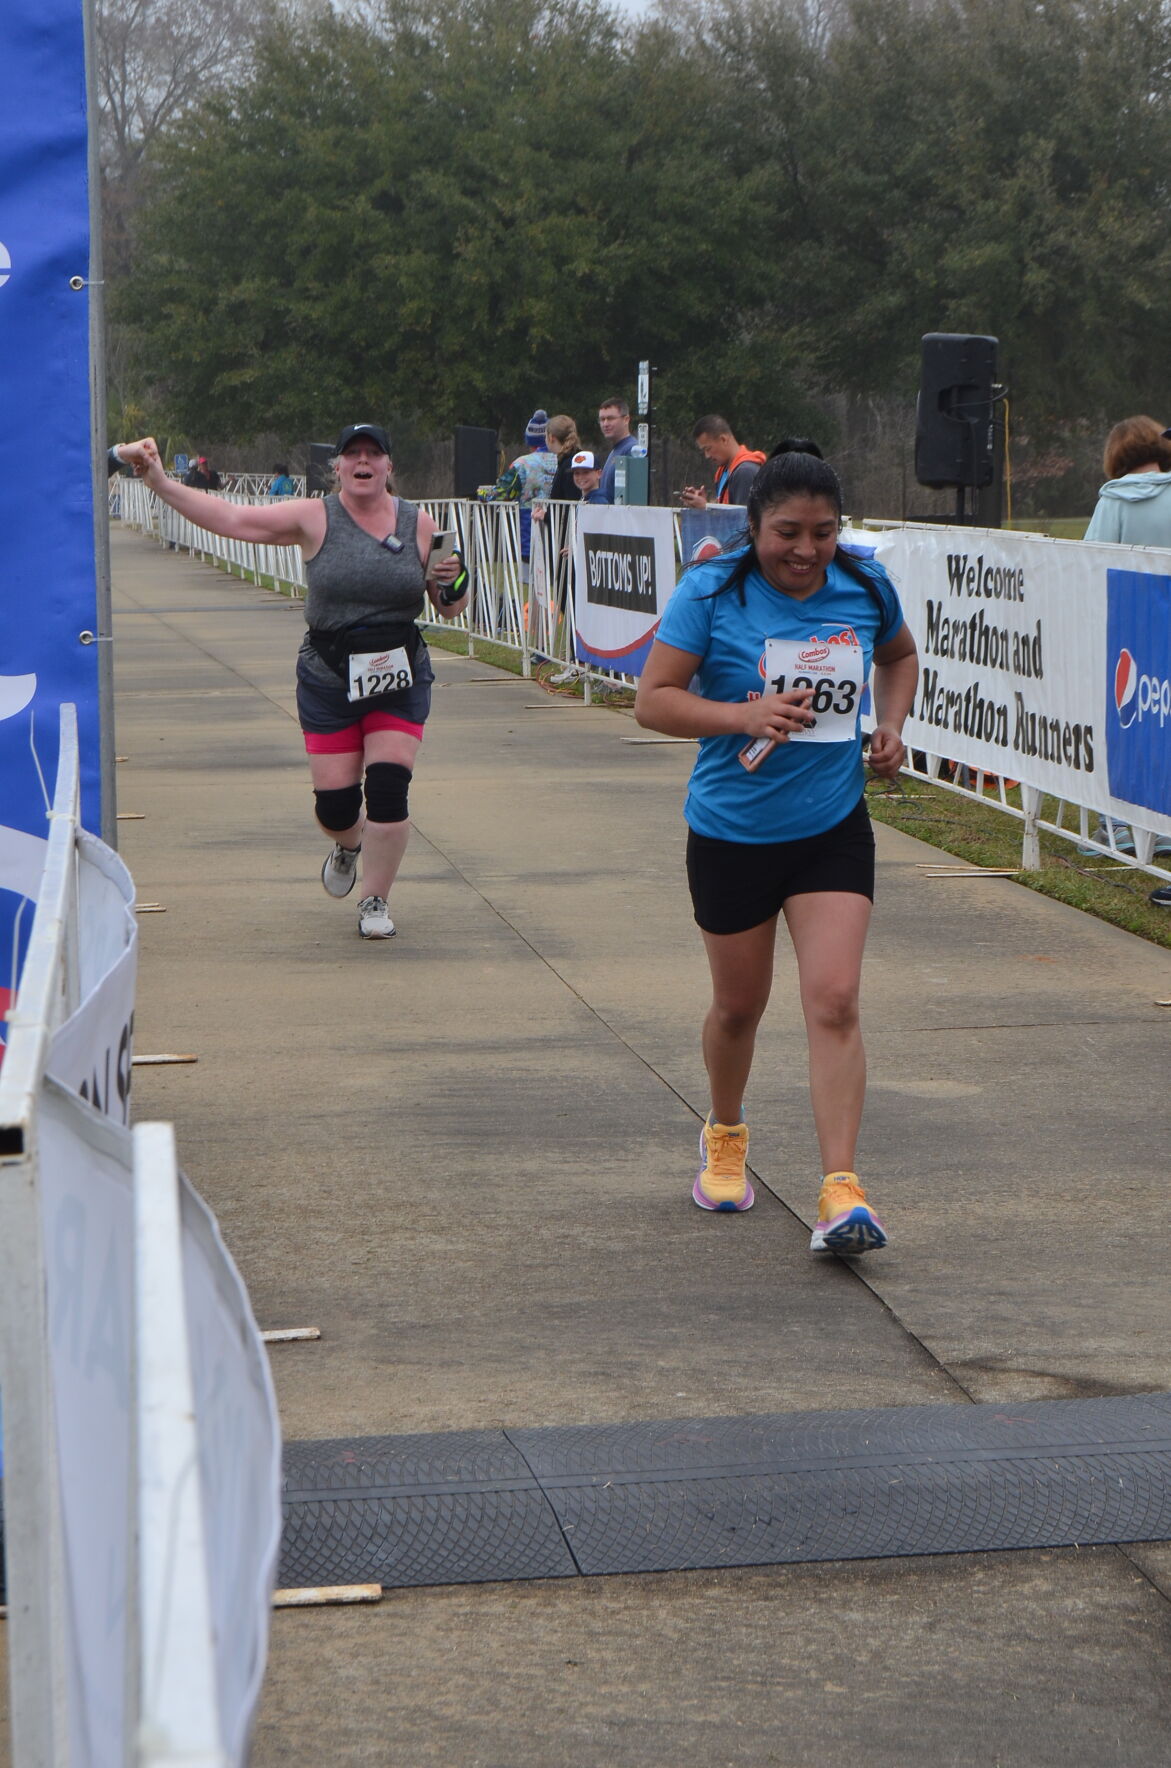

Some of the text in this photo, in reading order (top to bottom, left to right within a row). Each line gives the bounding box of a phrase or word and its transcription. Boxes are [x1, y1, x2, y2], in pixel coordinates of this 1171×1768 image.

[588, 550, 652, 595] BOTTOMS UP!
[947, 554, 1024, 602] Welcome
[801, 647, 828, 659] Combos
[925, 599, 1043, 680] Marathon and
[353, 669, 410, 697] 1228
[808, 664, 836, 673] MARATHON
[919, 668, 1094, 773] Marathon Runners
[1138, 674, 1171, 728] pep
